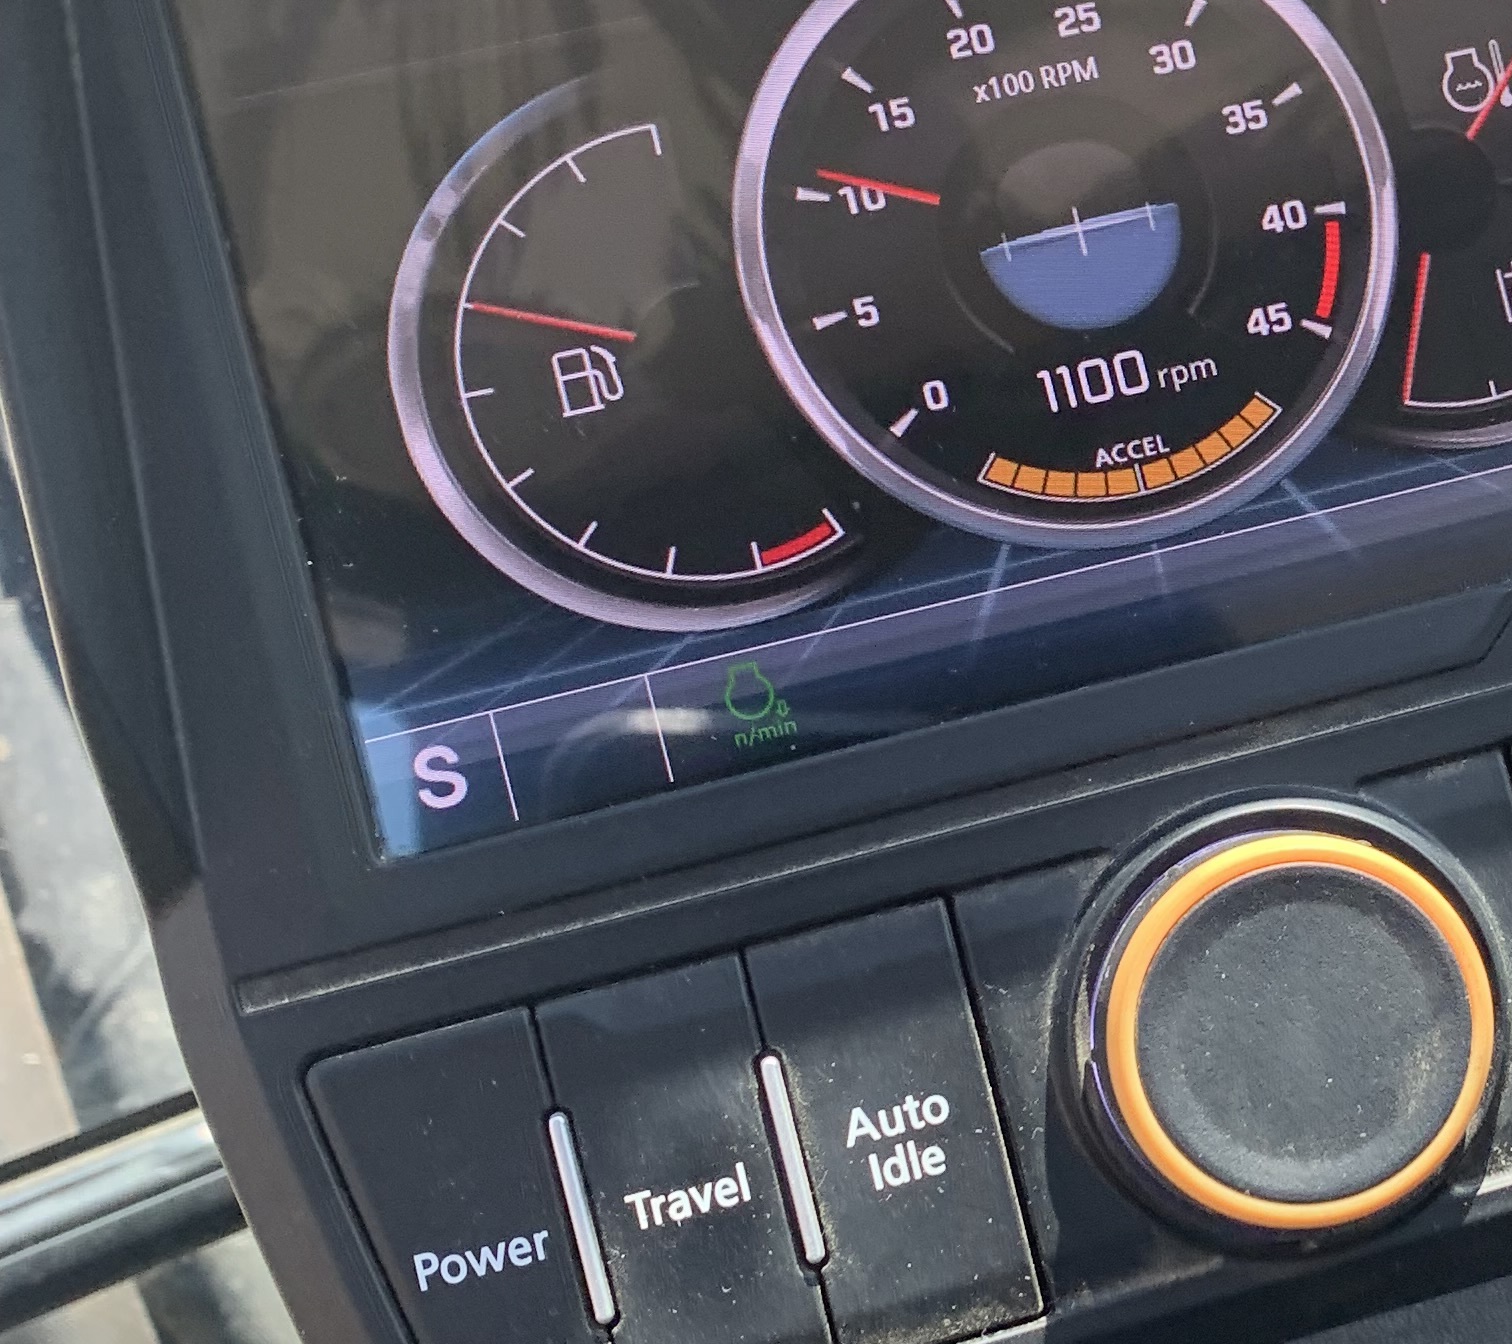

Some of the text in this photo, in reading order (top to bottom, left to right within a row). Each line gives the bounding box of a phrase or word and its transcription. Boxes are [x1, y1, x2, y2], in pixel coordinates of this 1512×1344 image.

[1054, 2, 1101, 38] 25
[946, 23, 995, 60] 20
[1148, 39, 1196, 74] 30
[972, 56, 1099, 104] x100 RPM
[868, 96, 916, 132] 15
[1221, 99, 1268, 135] 35
[837, 182, 887, 215] 10
[1261, 200, 1307, 233] 40
[852, 295, 880, 327] 5
[1246, 302, 1292, 336] 45
[922, 379, 949, 411] 0
[1036, 349, 1218, 413] 1100 rpm
[1095, 434, 1170, 468] ACCEL
[734, 718, 798, 749] n/min
[413, 744, 468, 809] S
[845, 1093, 950, 1148] Auto
[869, 1141, 946, 1192] Idle
[624, 1162, 753, 1230] Travel
[412, 1229, 549, 1292] Power
